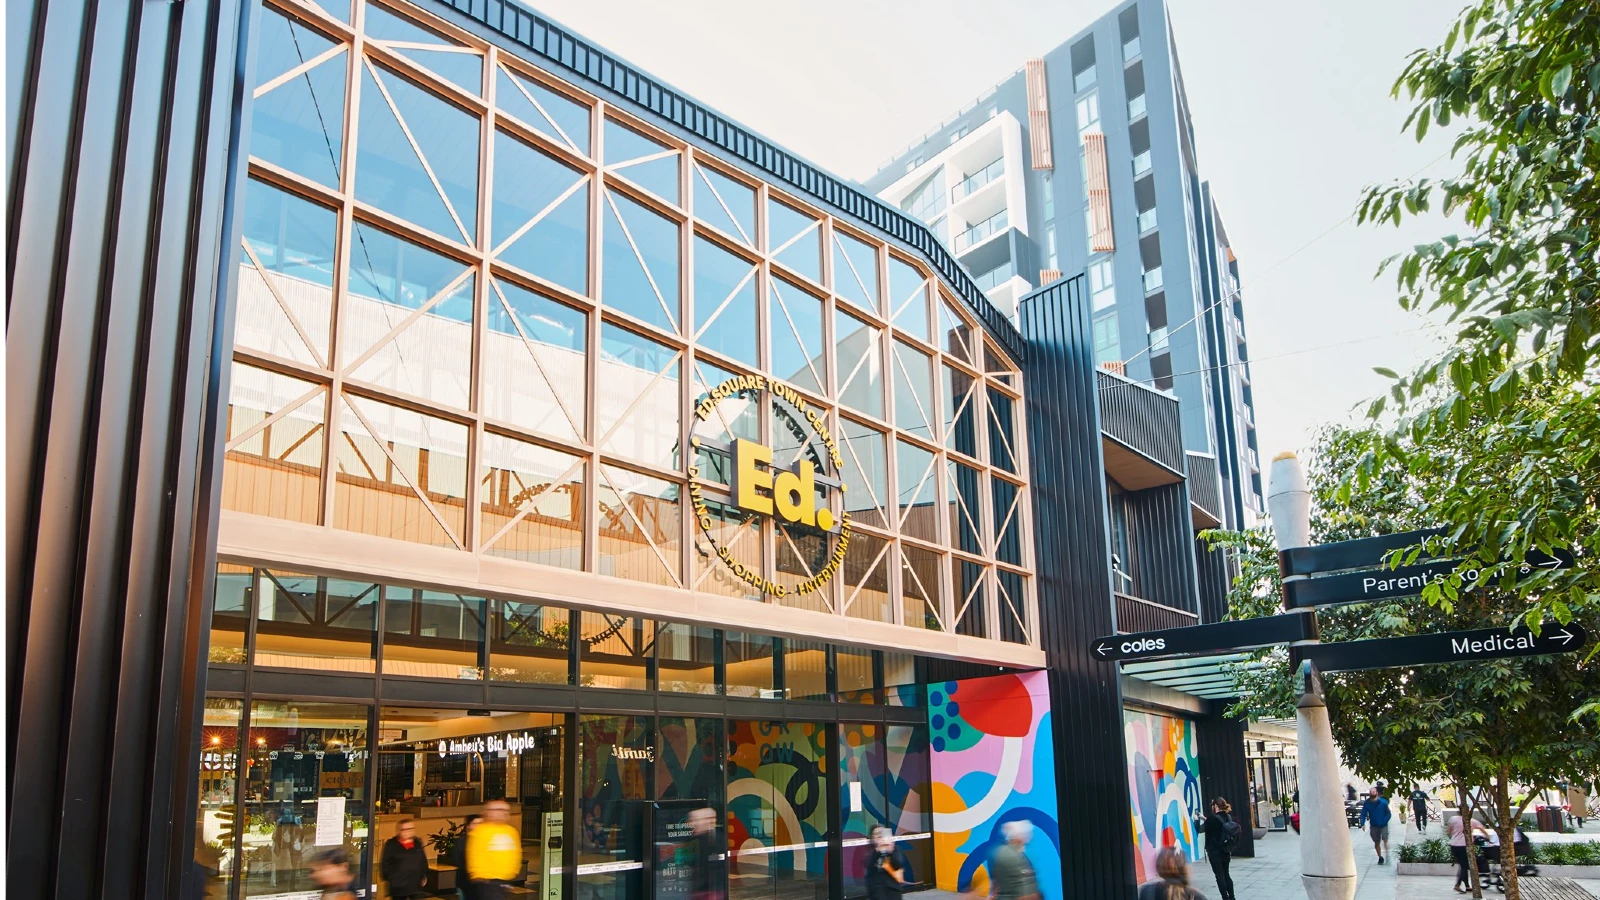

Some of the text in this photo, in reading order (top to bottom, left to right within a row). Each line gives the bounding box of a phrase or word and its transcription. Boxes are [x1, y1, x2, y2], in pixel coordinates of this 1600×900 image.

[766, 379, 806, 413] TOWN
[806, 408, 844, 470] CENTRE
[687, 465, 713, 531] DINING
[717, 545, 787, 598] SHOPPING
[797, 511, 852, 597] ENTERTAINMENT
[1363, 568, 1445, 593] Parent's
[1120, 638, 1166, 654] coles
[1451, 631, 1536, 655] Medical
[506, 731, 535, 755] Apple
